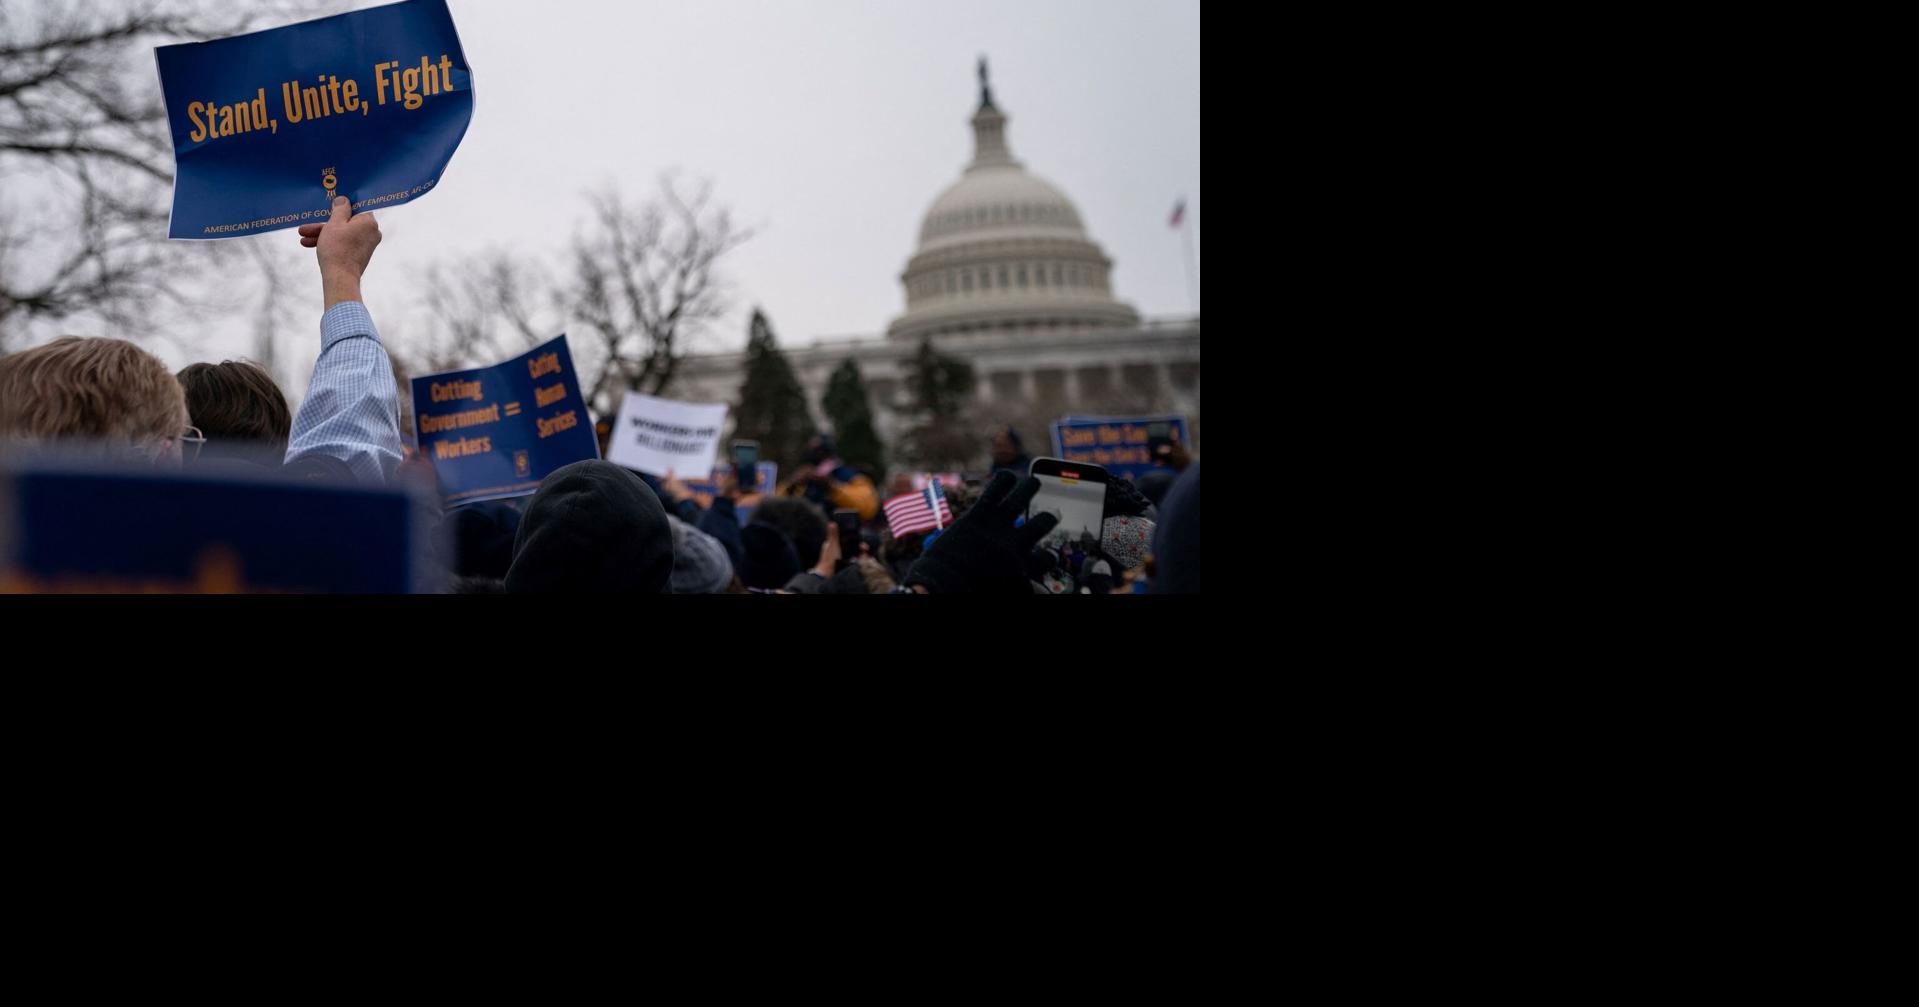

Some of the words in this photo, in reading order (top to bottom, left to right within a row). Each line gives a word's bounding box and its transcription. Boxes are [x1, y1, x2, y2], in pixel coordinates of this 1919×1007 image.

[187, 88, 277, 143] Stand,
[282, 74, 368, 124] Unite,
[374, 54, 454, 110] Fight
[204, 222, 250, 233] AMERICAN
[251, 212, 299, 229] FEDERATION
[301, 211, 313, 219] OF
[431, 379, 484, 402] Cutting
[419, 403, 500, 434] Government
[536, 410, 577, 439] Services
[434, 436, 492, 460] Workers
